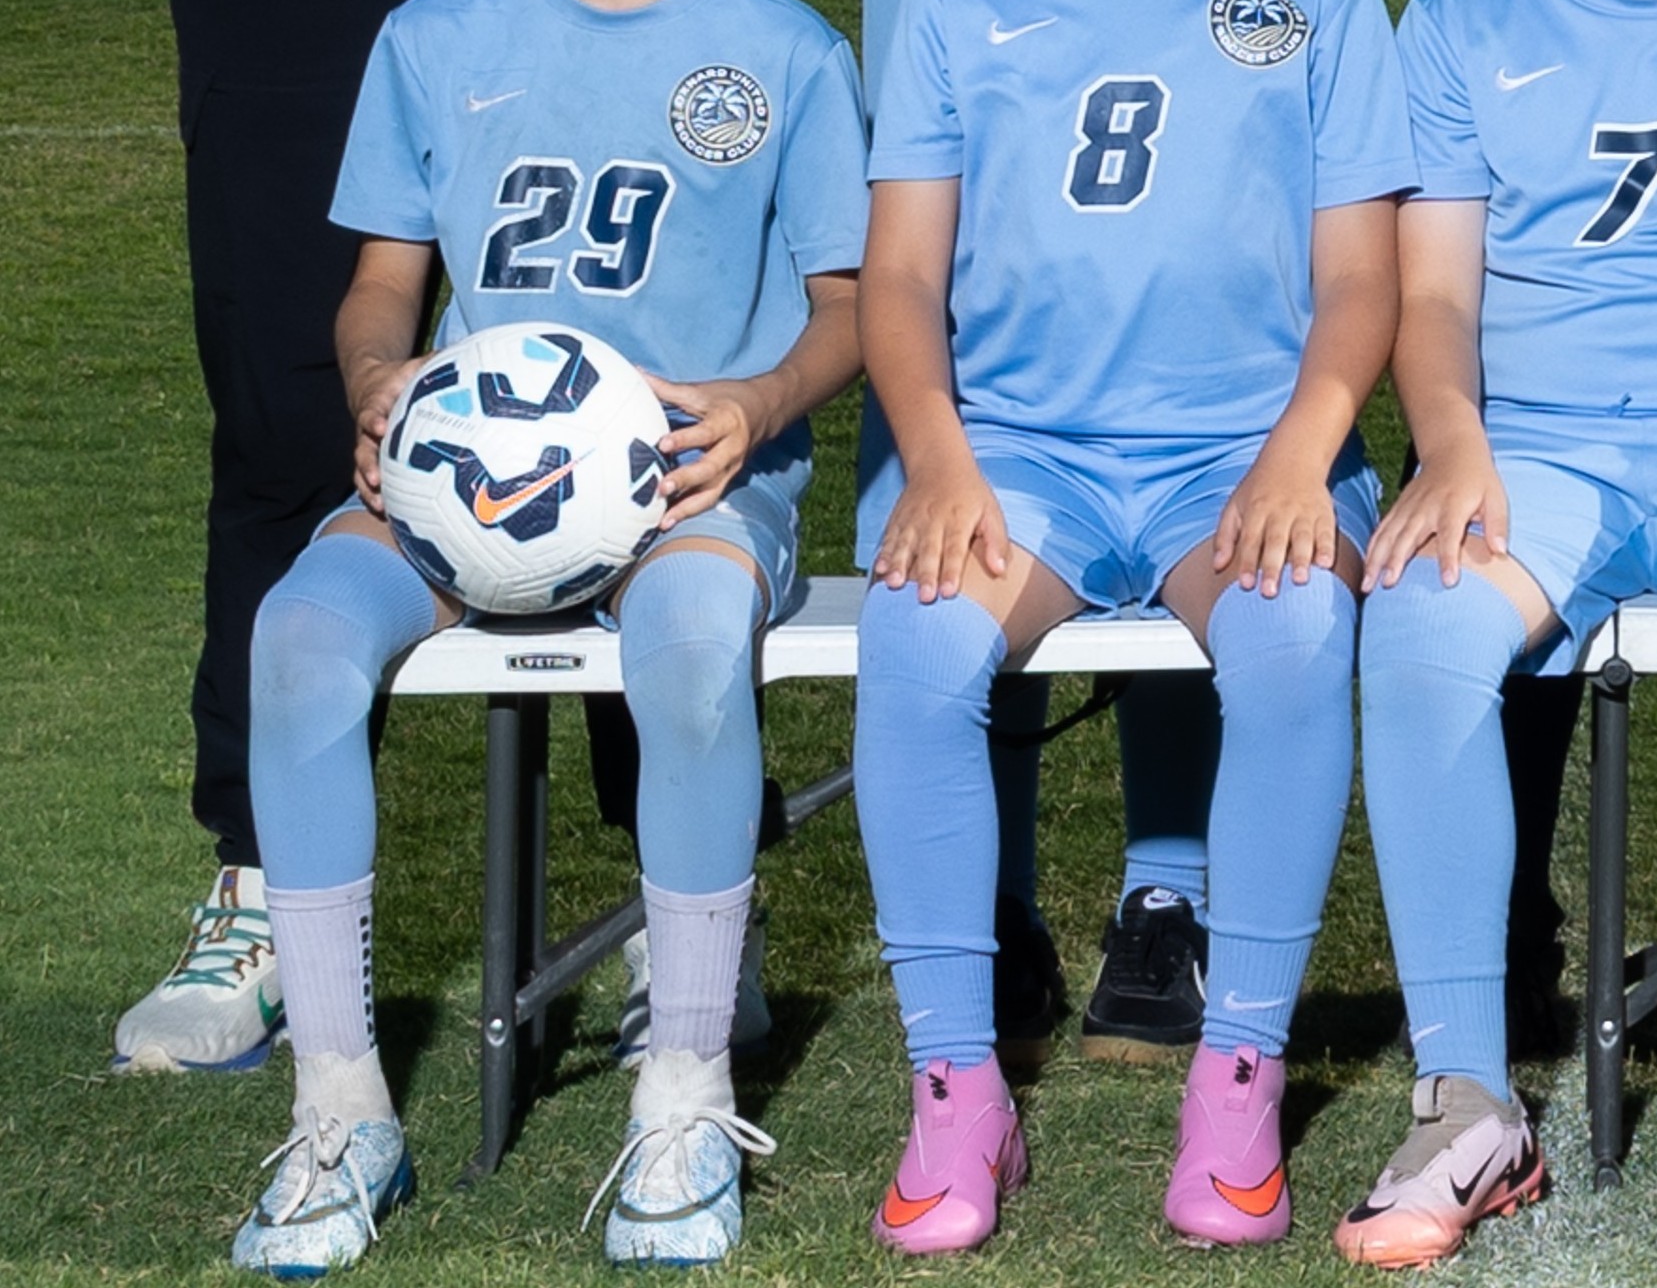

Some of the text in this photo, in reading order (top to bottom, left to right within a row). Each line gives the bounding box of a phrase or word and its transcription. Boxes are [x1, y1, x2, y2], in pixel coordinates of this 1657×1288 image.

[1215, 24, 1302, 62] SOCCER CLUB
[730, 70, 766, 117] UNITED
[674, 121, 761, 160] SOCCER CLUB
[1062, 74, 1172, 213] 8
[473, 155, 677, 298] 29
